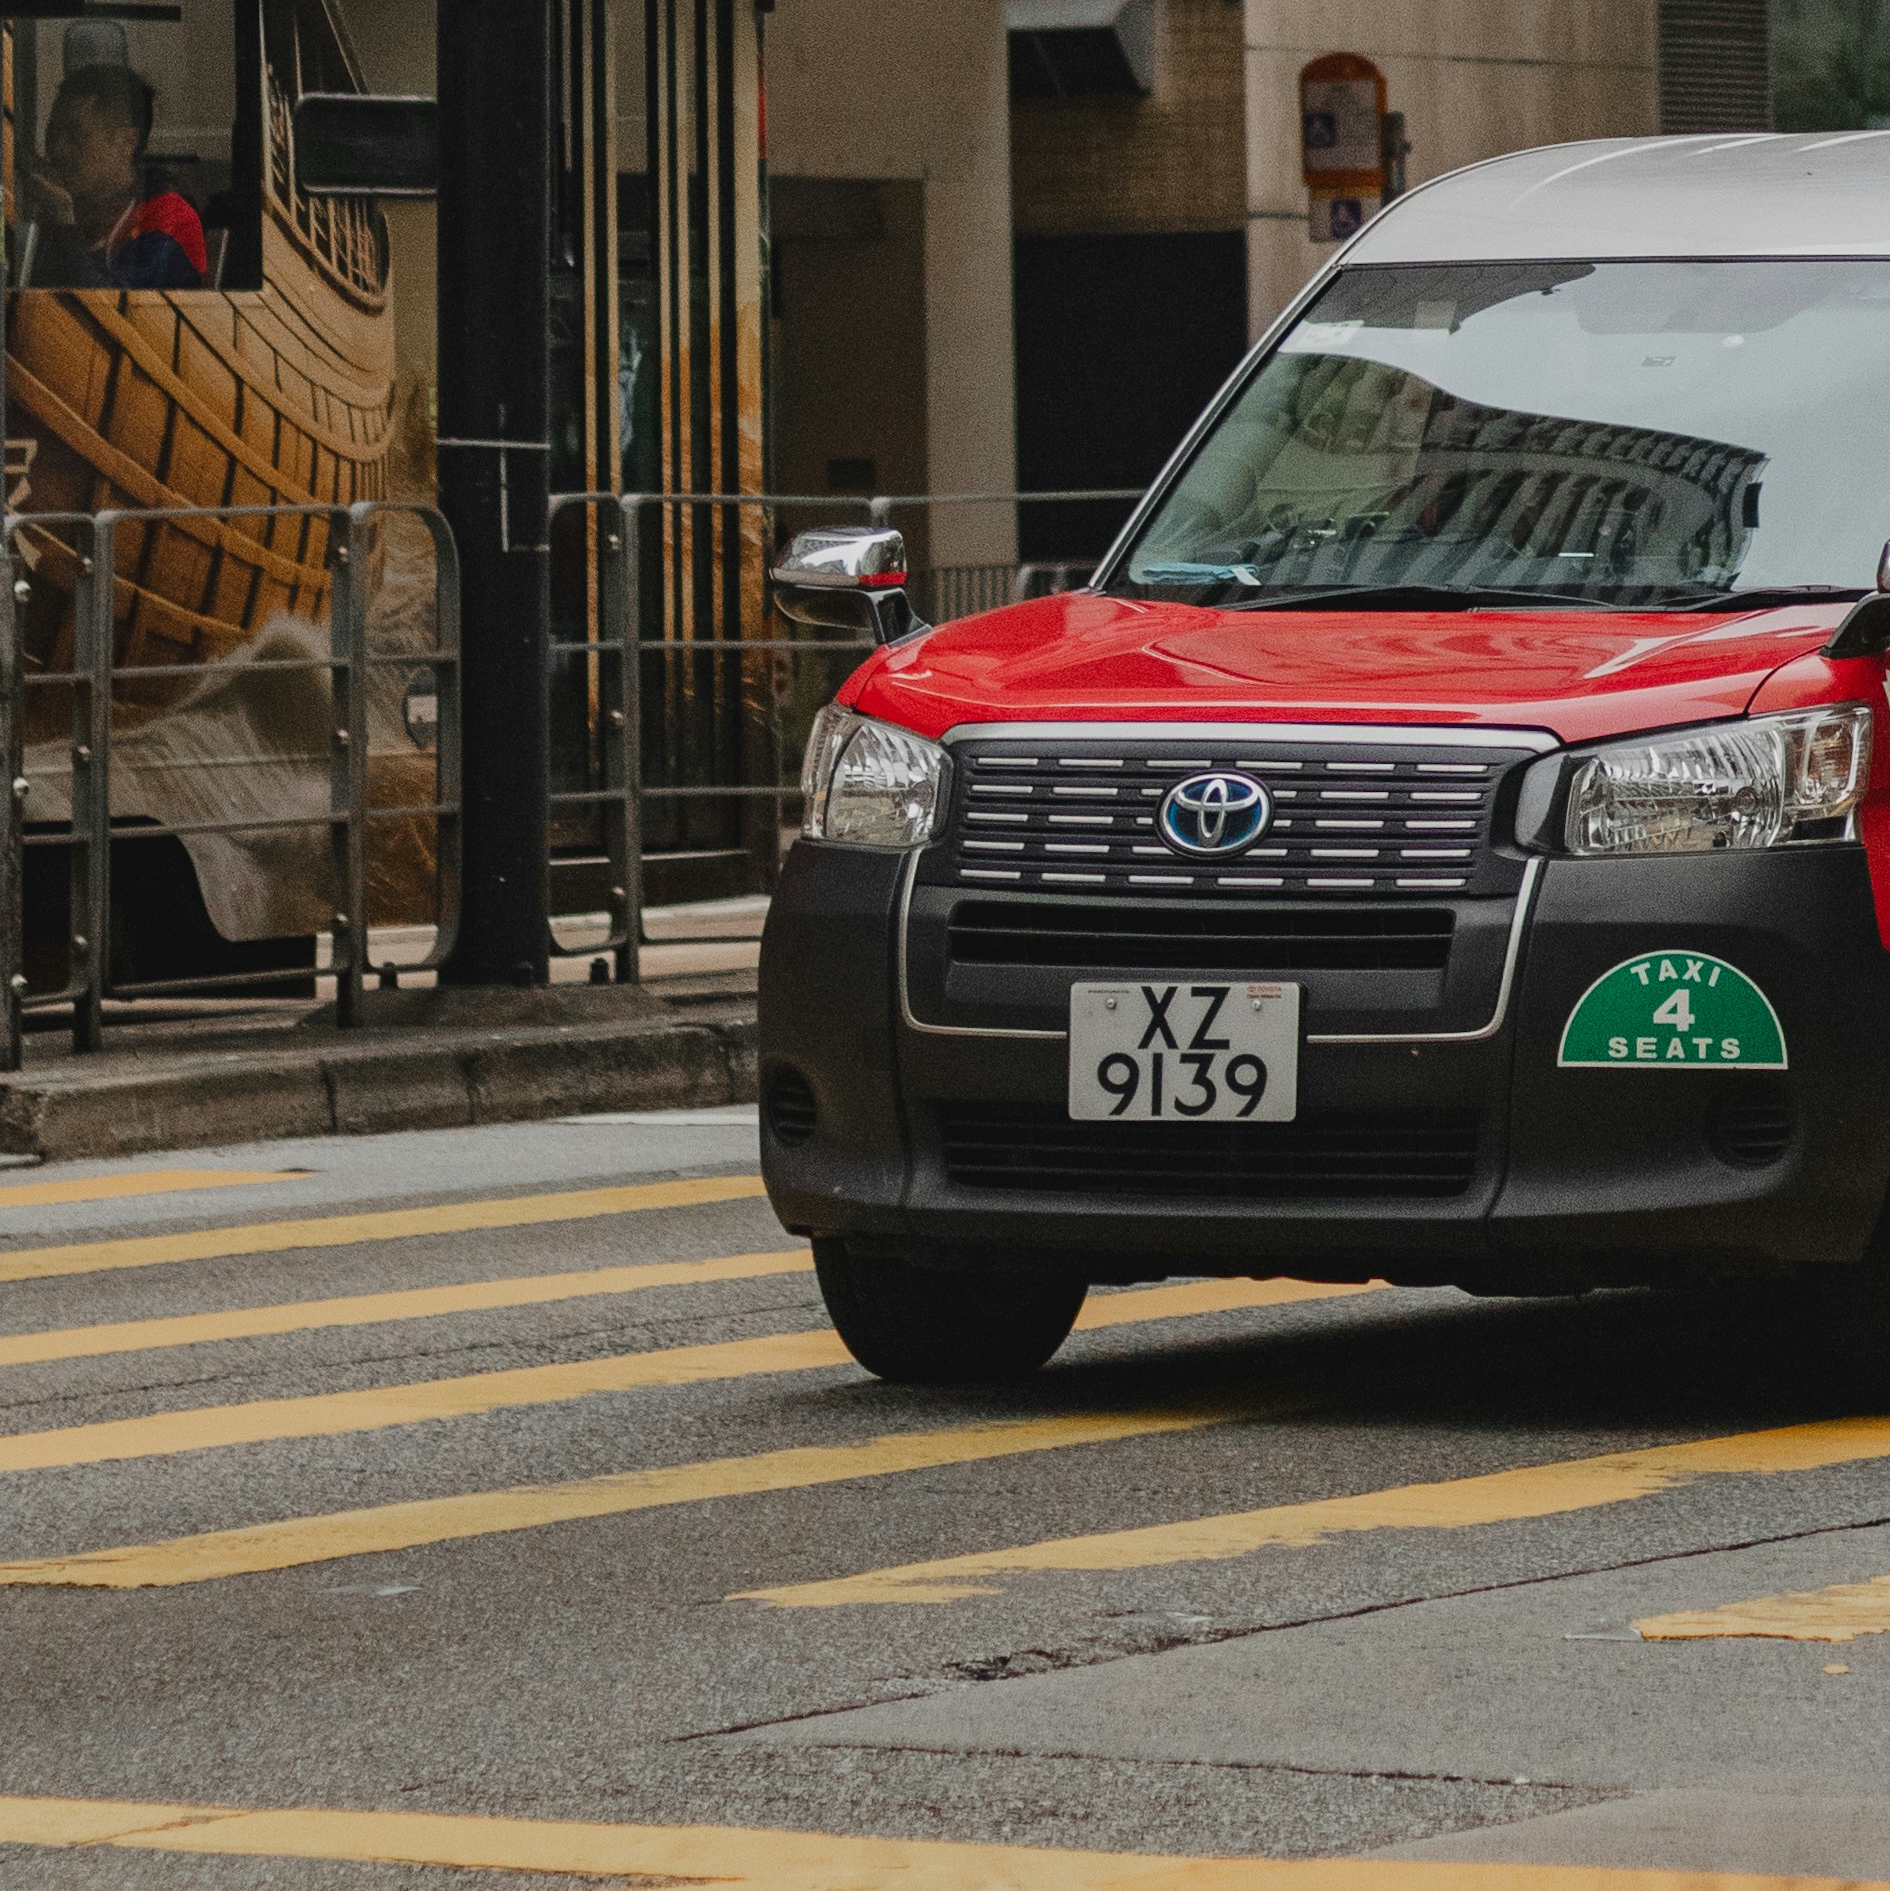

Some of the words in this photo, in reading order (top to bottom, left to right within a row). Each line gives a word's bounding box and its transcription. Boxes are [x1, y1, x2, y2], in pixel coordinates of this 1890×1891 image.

[1630, 952, 1721, 988] TAXI
[1138, 986, 1231, 1051] XZ
[1653, 989, 1695, 1032] 4
[1608, 1037, 1741, 1060] SEATS
[1097, 1052, 1268, 1118] 9139
